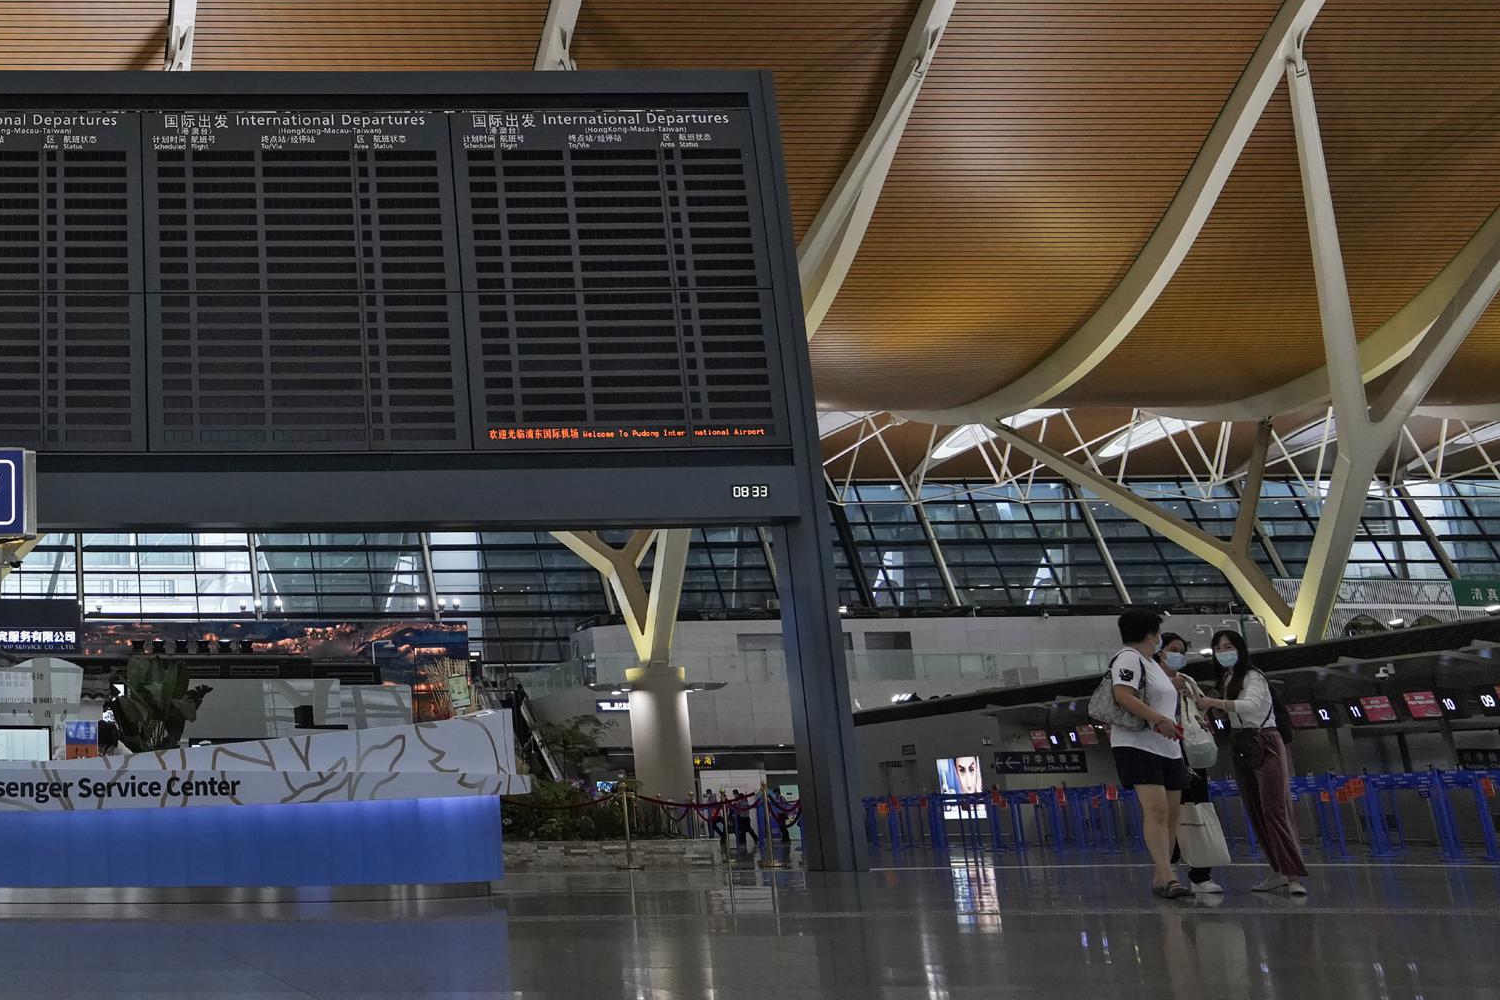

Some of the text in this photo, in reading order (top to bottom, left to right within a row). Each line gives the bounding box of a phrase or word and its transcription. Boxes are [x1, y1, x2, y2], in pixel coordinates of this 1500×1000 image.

[33, 114, 117, 129] Departures
[165, 115, 228, 129] 国际出发
[236, 114, 426, 129] International Departures
[473, 114, 535, 129] 国际出发
[542, 112, 730, 127] International Departures
[47, 135, 55, 143] 区
[357, 135, 364, 143] 区
[463, 135, 495, 144] 计划时间
[500, 135, 524, 144] 航班号
[191, 142, 208, 150] Flight
[500, 142, 517, 150] Flight
[490, 429, 578, 439] 欢迎光临浦东国际机场
[583, 430, 615, 438] Welcome
[619, 429, 629, 438] To
[632, 429, 660, 439] Pudong
[734, 428, 765, 437] Airport
[1471, 588, 1499, 601] 清真
[1443, 698, 1456, 711] 10
[1480, 694, 1496, 707] 09
[1318, 709, 1330, 720] 12
[1350, 706, 1361, 718] 11
[77, 775, 162, 798] Service
[165, 775, 241, 798] Center
